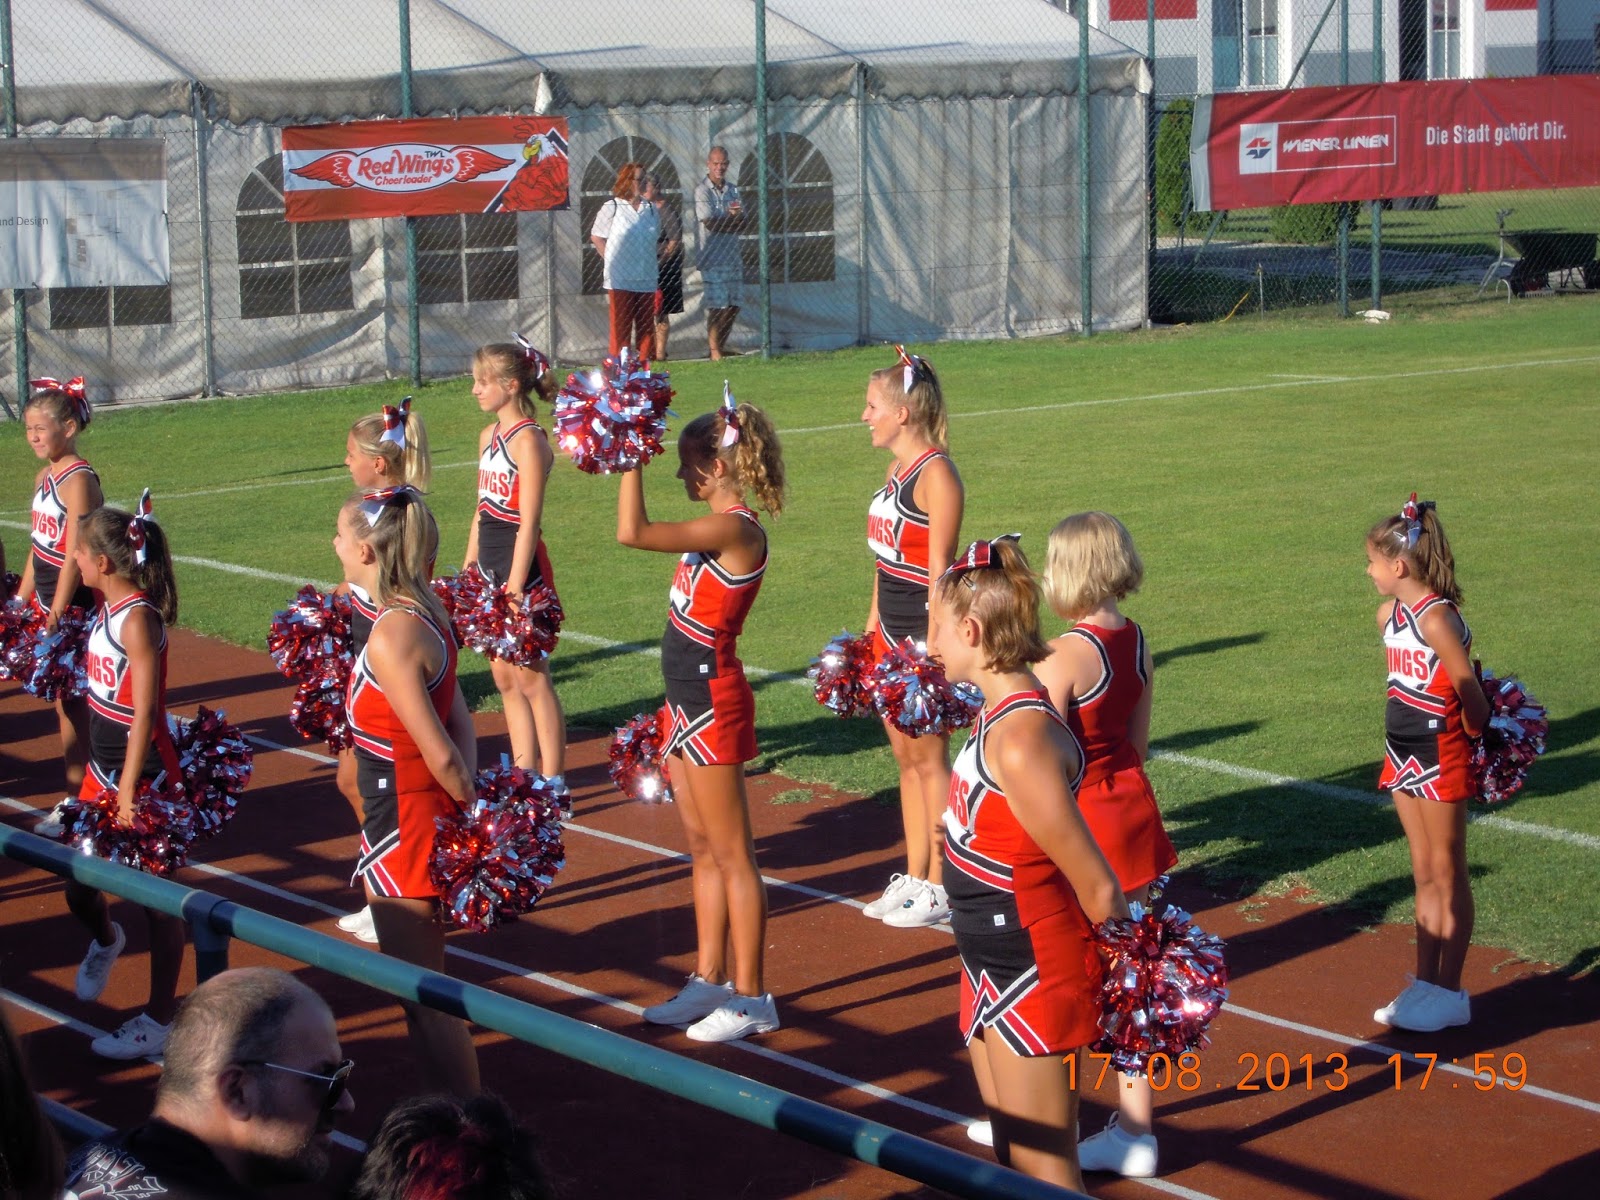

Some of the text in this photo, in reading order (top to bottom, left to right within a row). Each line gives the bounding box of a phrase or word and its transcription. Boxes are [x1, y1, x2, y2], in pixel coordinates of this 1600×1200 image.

[1426, 121, 1567, 146] Die Stadt gehört Dir.
[1283, 134, 1389, 153] WIENER LINIEN
[357, 149, 455, 180] Red Wings
[374, 174, 433, 186] Cheerleader
[16, 216, 49, 228] Design
